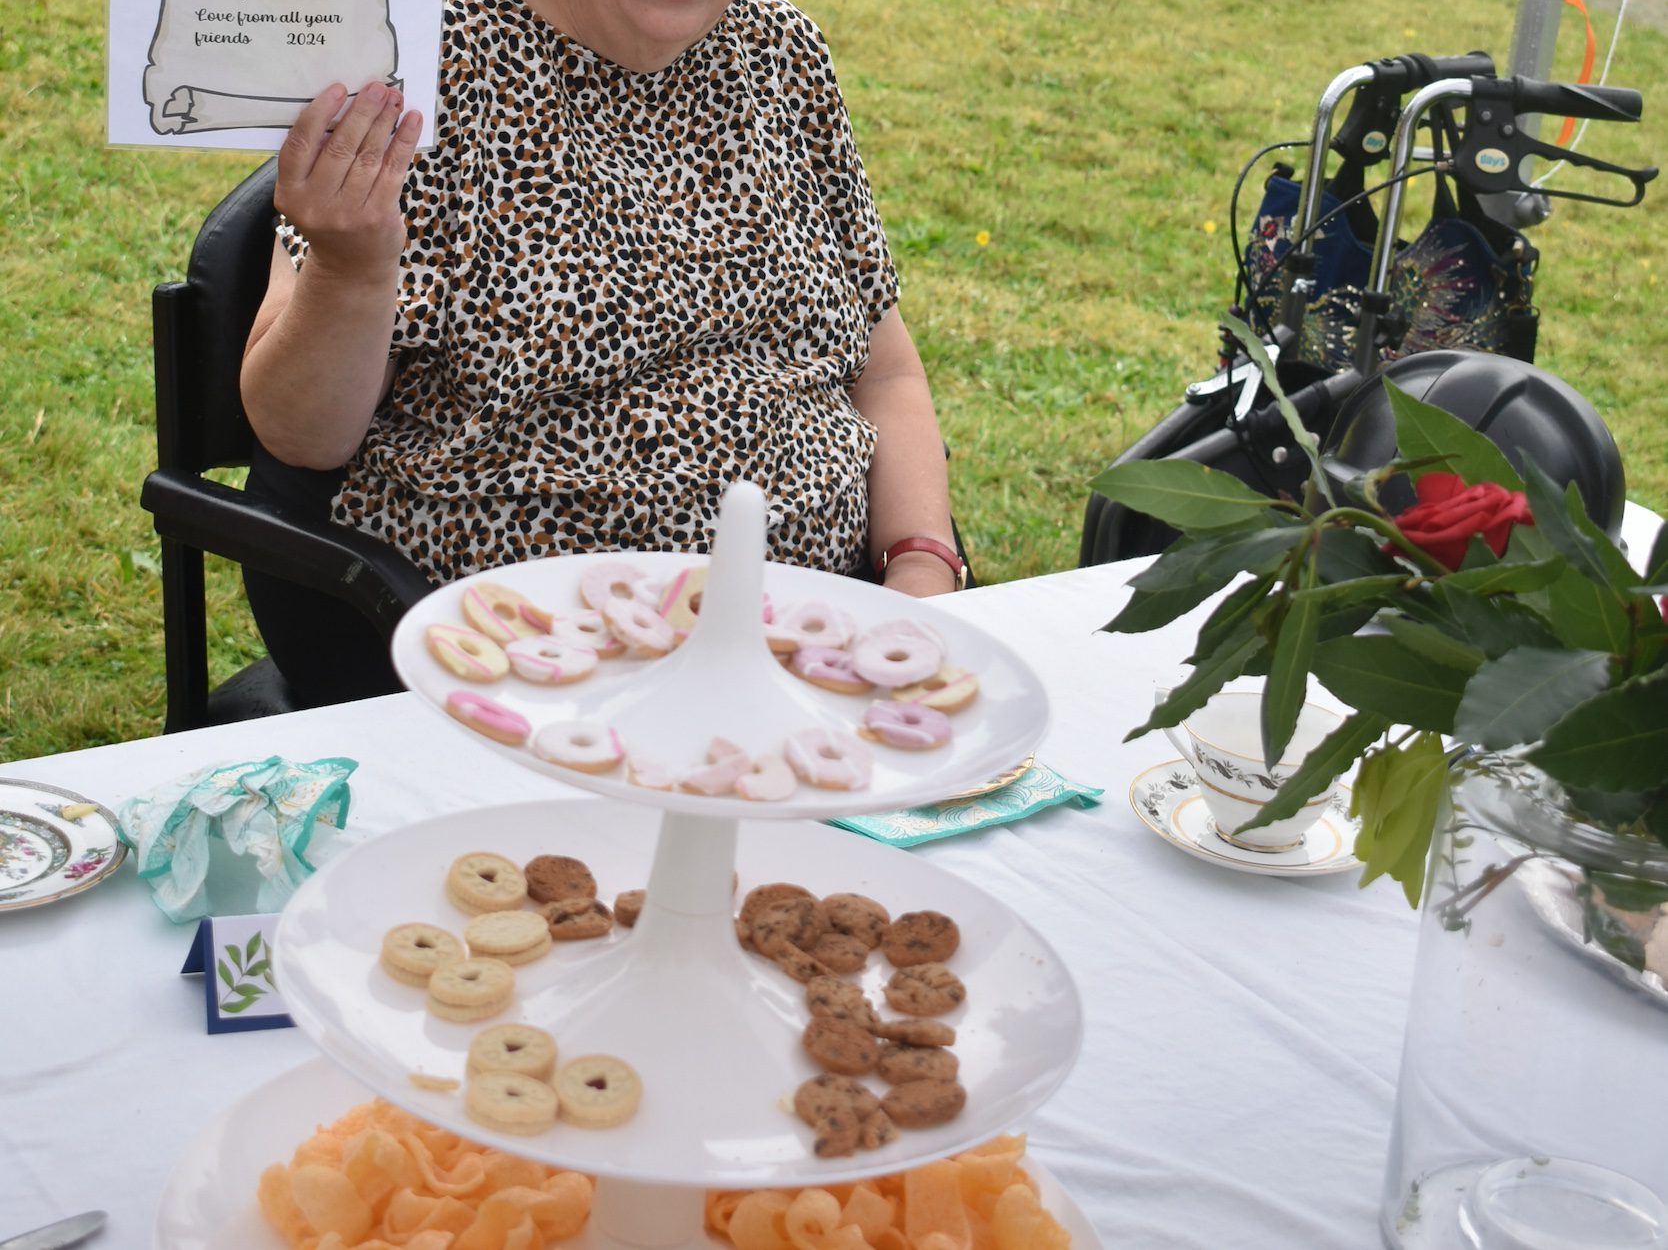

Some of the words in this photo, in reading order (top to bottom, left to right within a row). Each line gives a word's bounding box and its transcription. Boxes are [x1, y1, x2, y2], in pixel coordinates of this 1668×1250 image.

[195, 8, 235, 23] Love
[236, 10, 277, 26] from
[279, 11, 302, 24] all
[304, 13, 344, 27] your
[194, 31, 252, 47] friends
[286, 32, 327, 46] 2024
